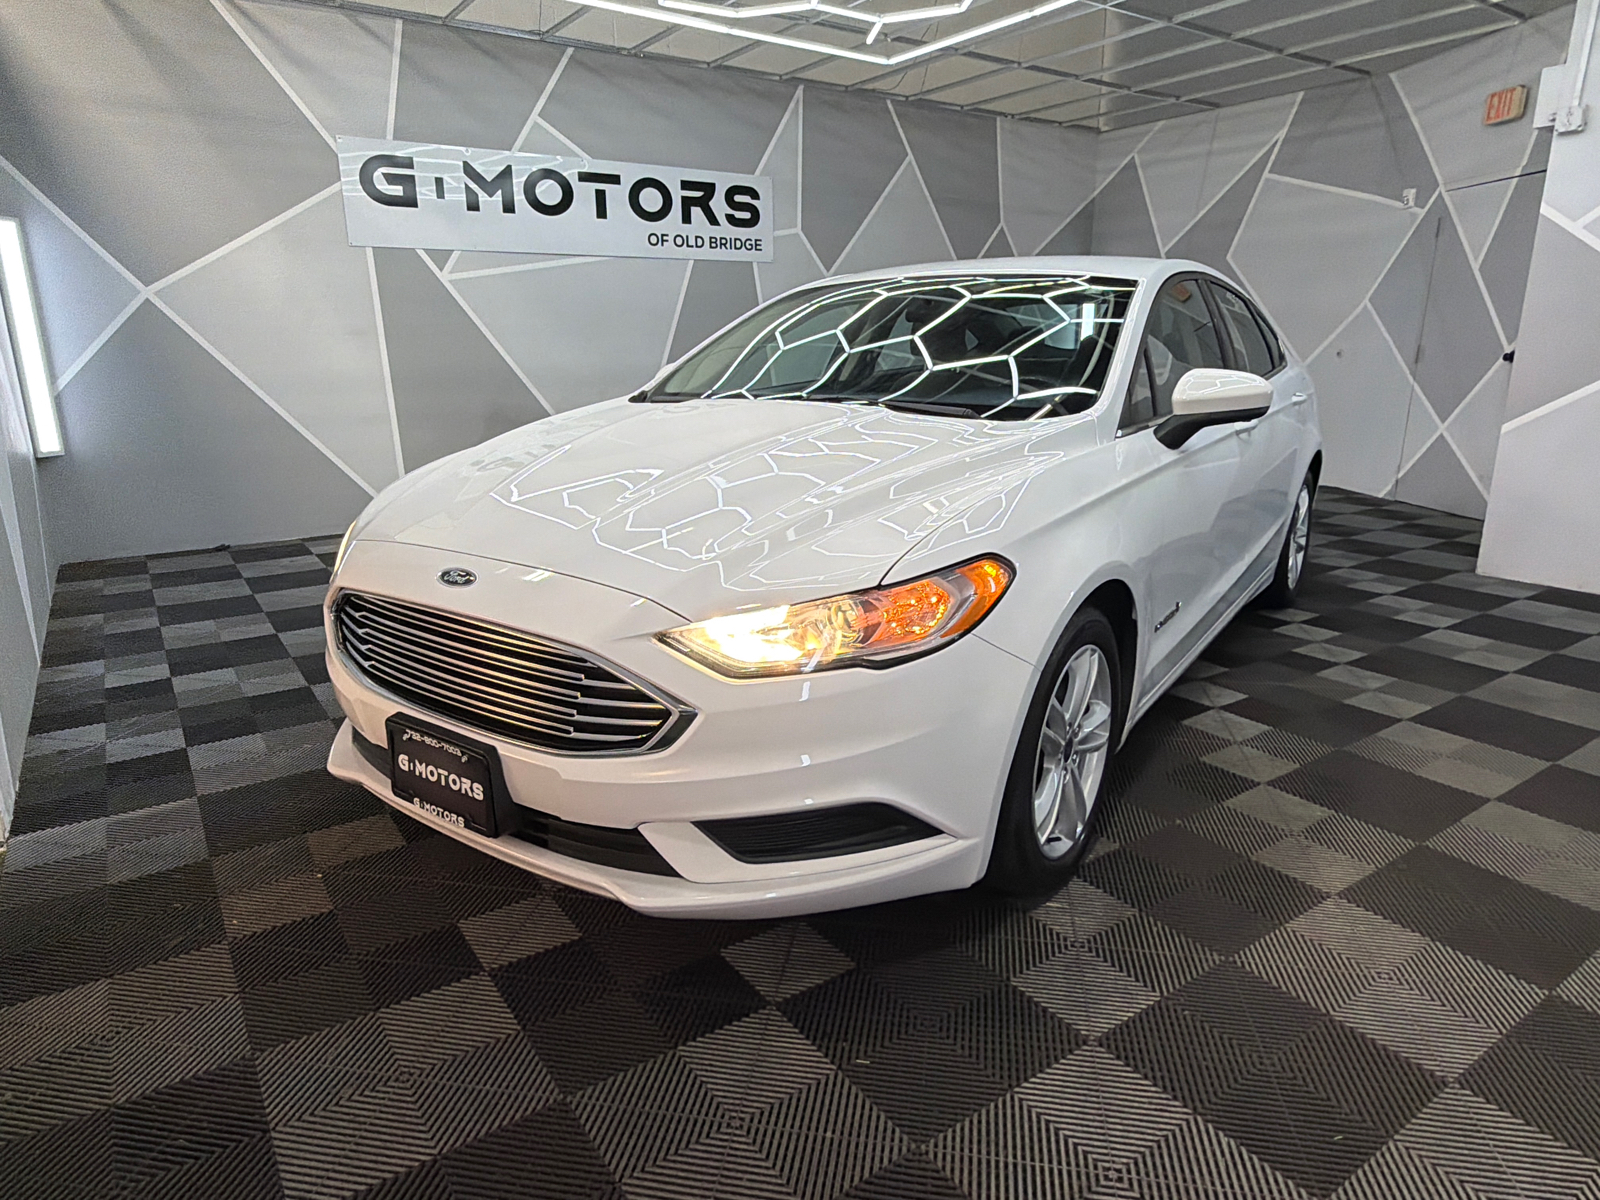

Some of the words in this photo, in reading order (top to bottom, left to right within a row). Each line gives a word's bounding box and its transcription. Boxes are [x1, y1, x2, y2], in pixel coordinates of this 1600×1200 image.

[1486, 87, 1517, 122] EXIT
[647, 232, 670, 247] OF
[673, 234, 705, 249] OLD
[708, 236, 763, 252] BRIDGE
